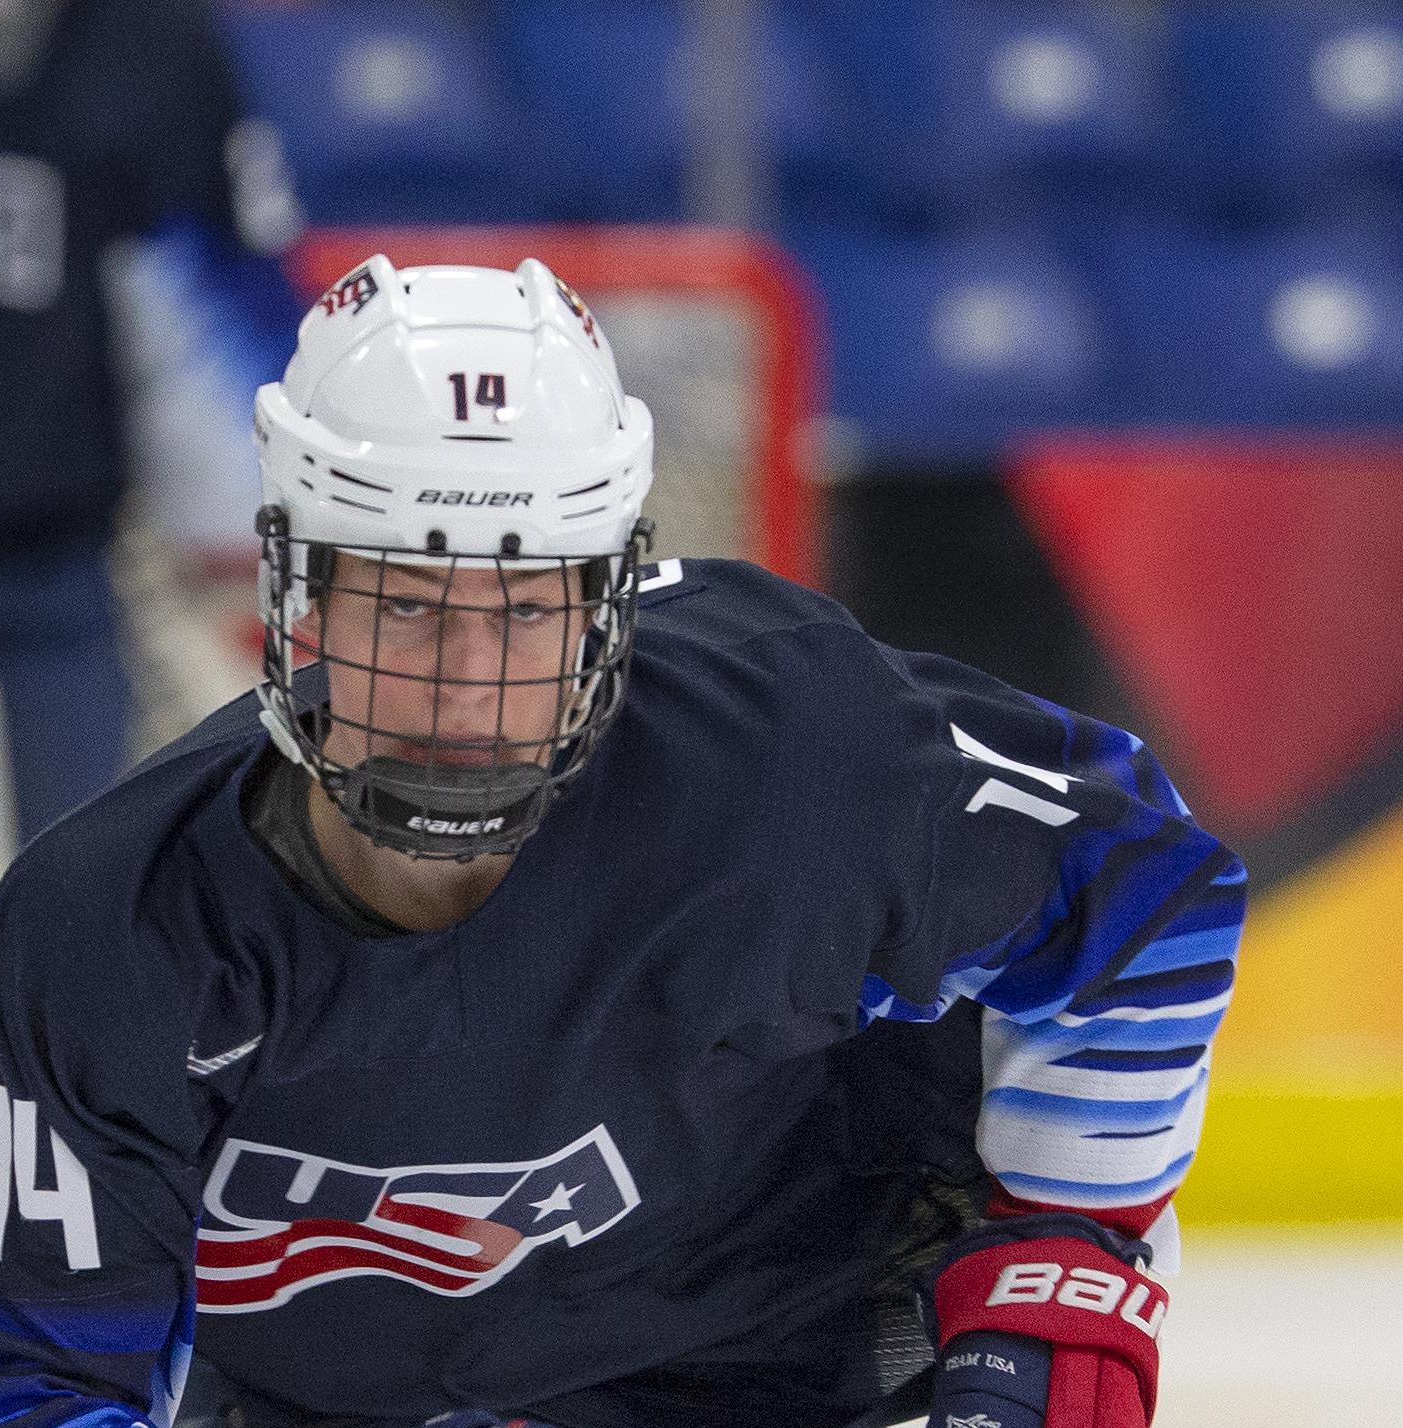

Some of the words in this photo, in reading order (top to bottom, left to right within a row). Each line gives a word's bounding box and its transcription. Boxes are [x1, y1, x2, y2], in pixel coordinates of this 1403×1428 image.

[447, 373, 508, 425] 14
[415, 489, 534, 507] BAUER
[406, 815, 506, 835] BAUER
[195, 1123, 642, 1313] USA
[986, 1262, 1166, 1338] BAU
[984, 1353, 1017, 1375] USA
